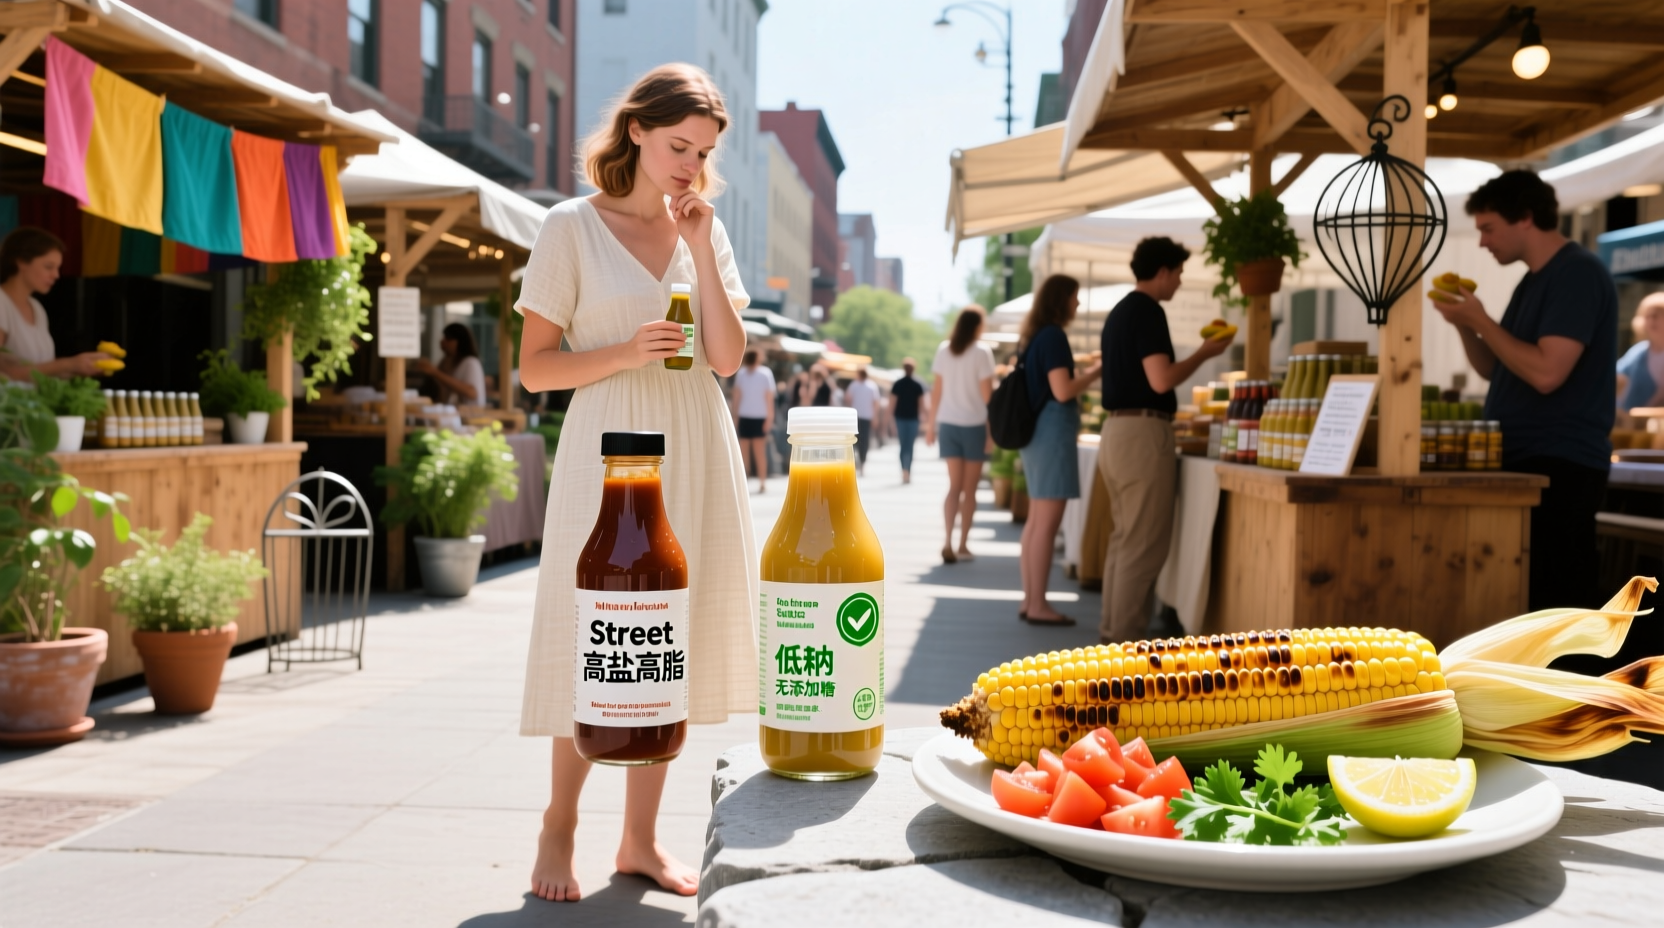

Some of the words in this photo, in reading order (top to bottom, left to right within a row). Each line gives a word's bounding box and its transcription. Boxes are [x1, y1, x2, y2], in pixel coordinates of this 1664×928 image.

[589, 619, 674, 646] Street
[583, 649, 685, 684] 高盐高脂
